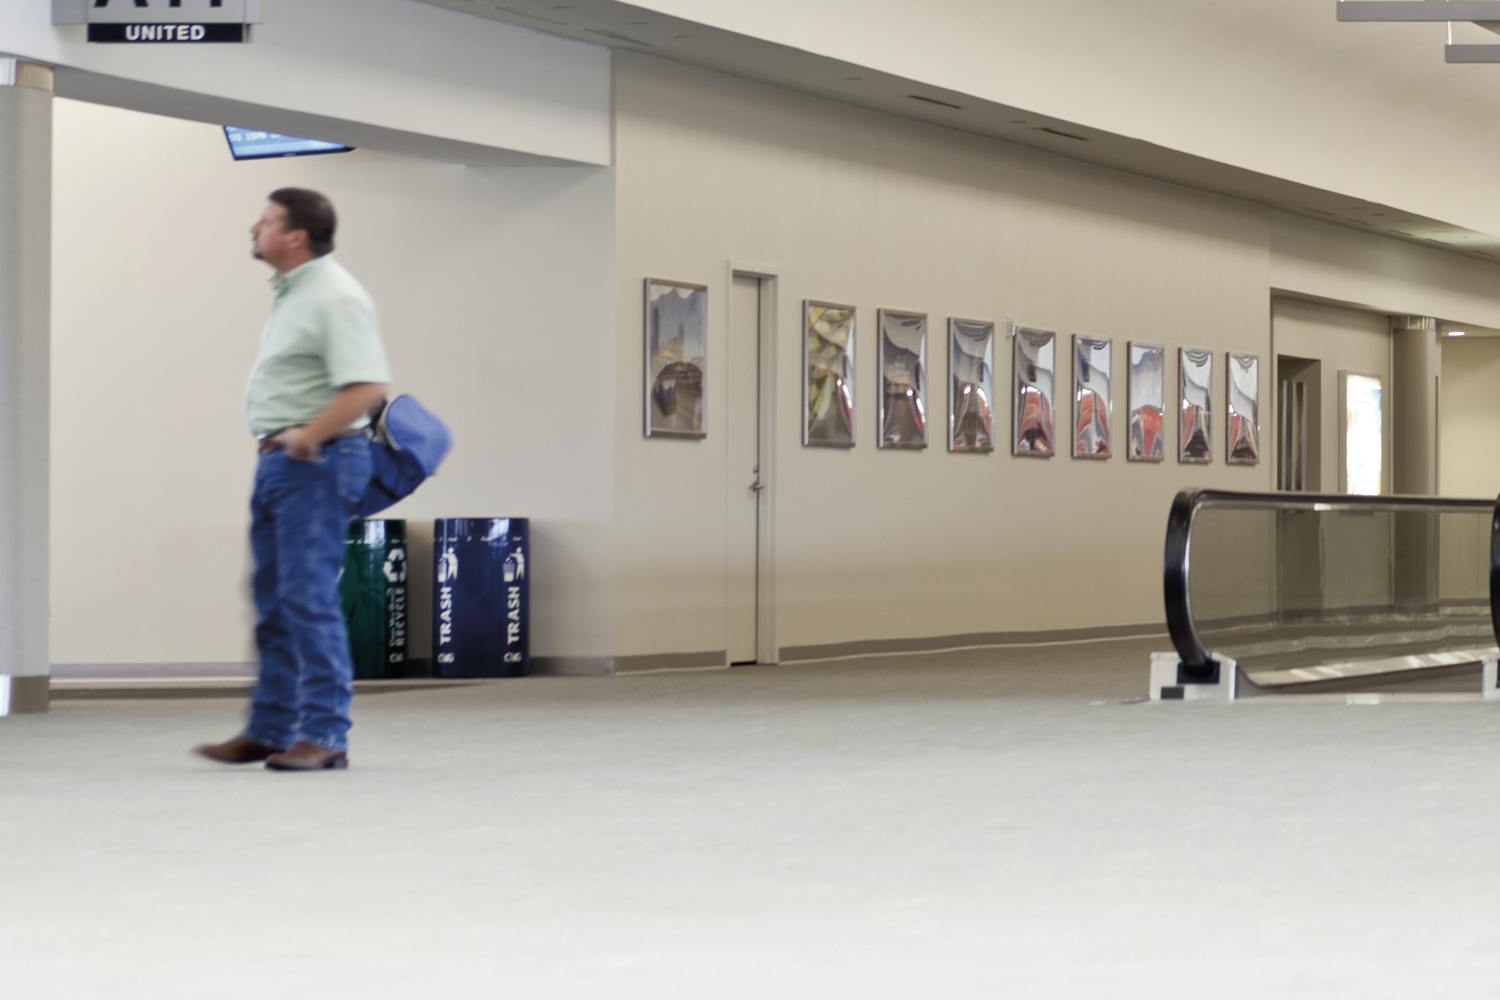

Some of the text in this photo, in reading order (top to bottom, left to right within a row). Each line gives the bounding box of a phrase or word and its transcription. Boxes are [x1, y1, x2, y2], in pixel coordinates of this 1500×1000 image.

[126, 25, 205, 41] UNITED
[439, 586, 452, 645] TRASH
[507, 586, 520, 645] TRASH
